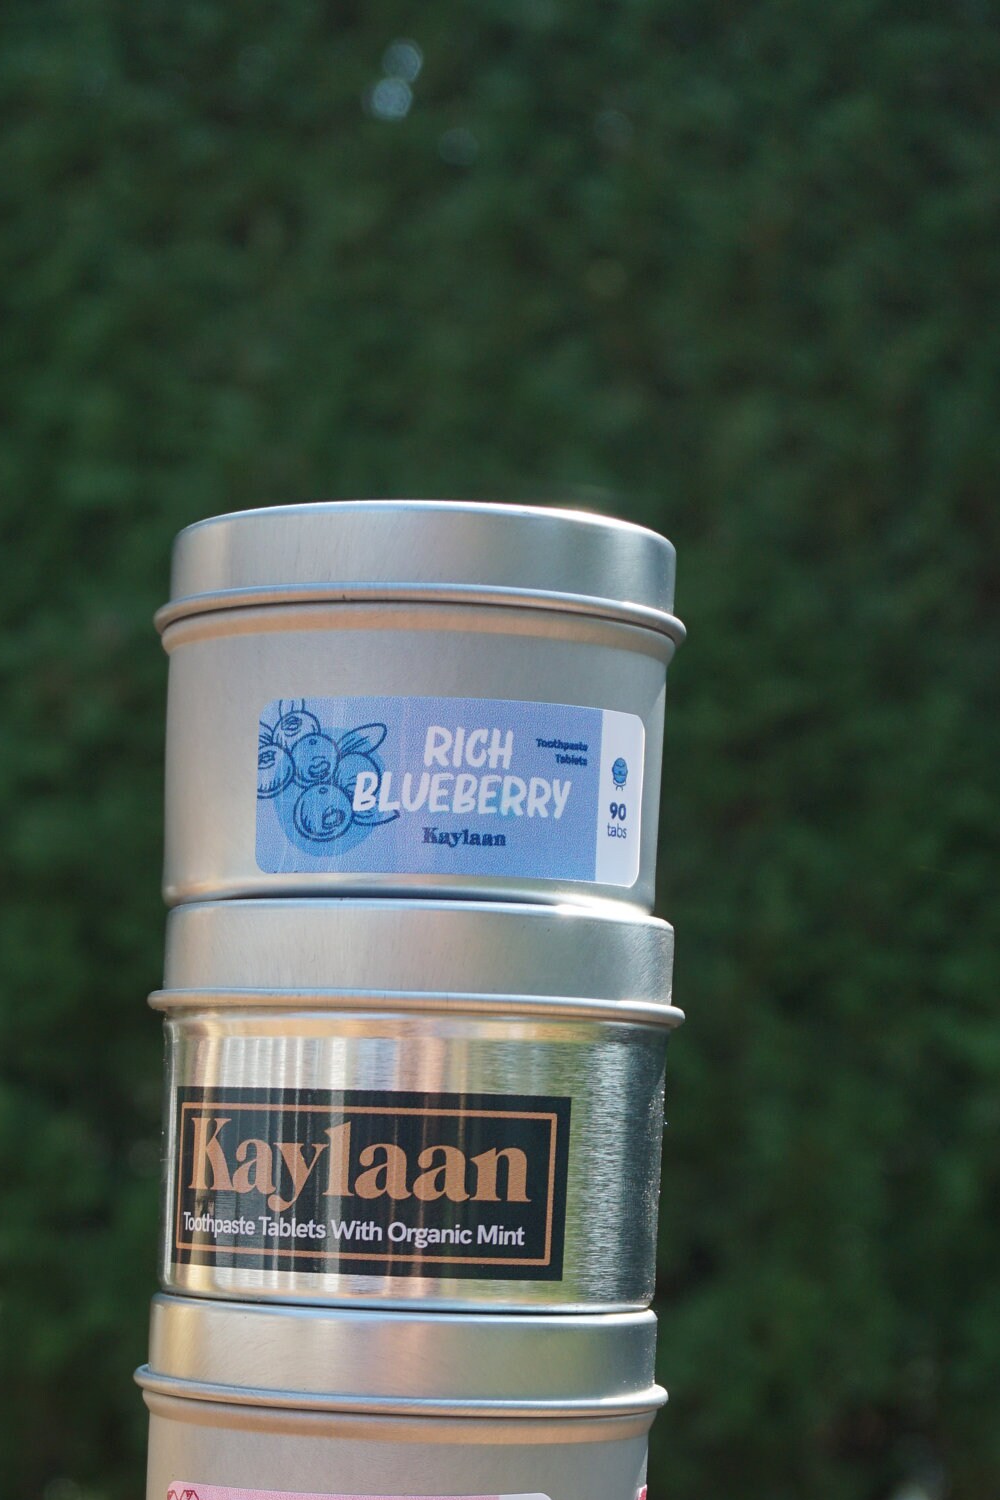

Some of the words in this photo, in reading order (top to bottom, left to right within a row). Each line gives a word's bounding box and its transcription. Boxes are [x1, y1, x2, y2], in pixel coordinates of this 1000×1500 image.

[424, 726, 513, 769] RICH
[536, 738, 588, 752] Toothpaste
[555, 753, 588, 766] Tablets
[353, 771, 571, 819] BLUEBERRY
[609, 802, 626, 821] 90
[421, 827, 507, 848] Kaylaan
[607, 821, 627, 839] tabs
[188, 1117, 532, 1212] Kaylaan
[184, 1211, 255, 1238] Toothpaste
[259, 1216, 326, 1240] Tablets
[330, 1220, 383, 1241] With
[387, 1221, 472, 1248] Organic
[477, 1225, 525, 1246] Mint
